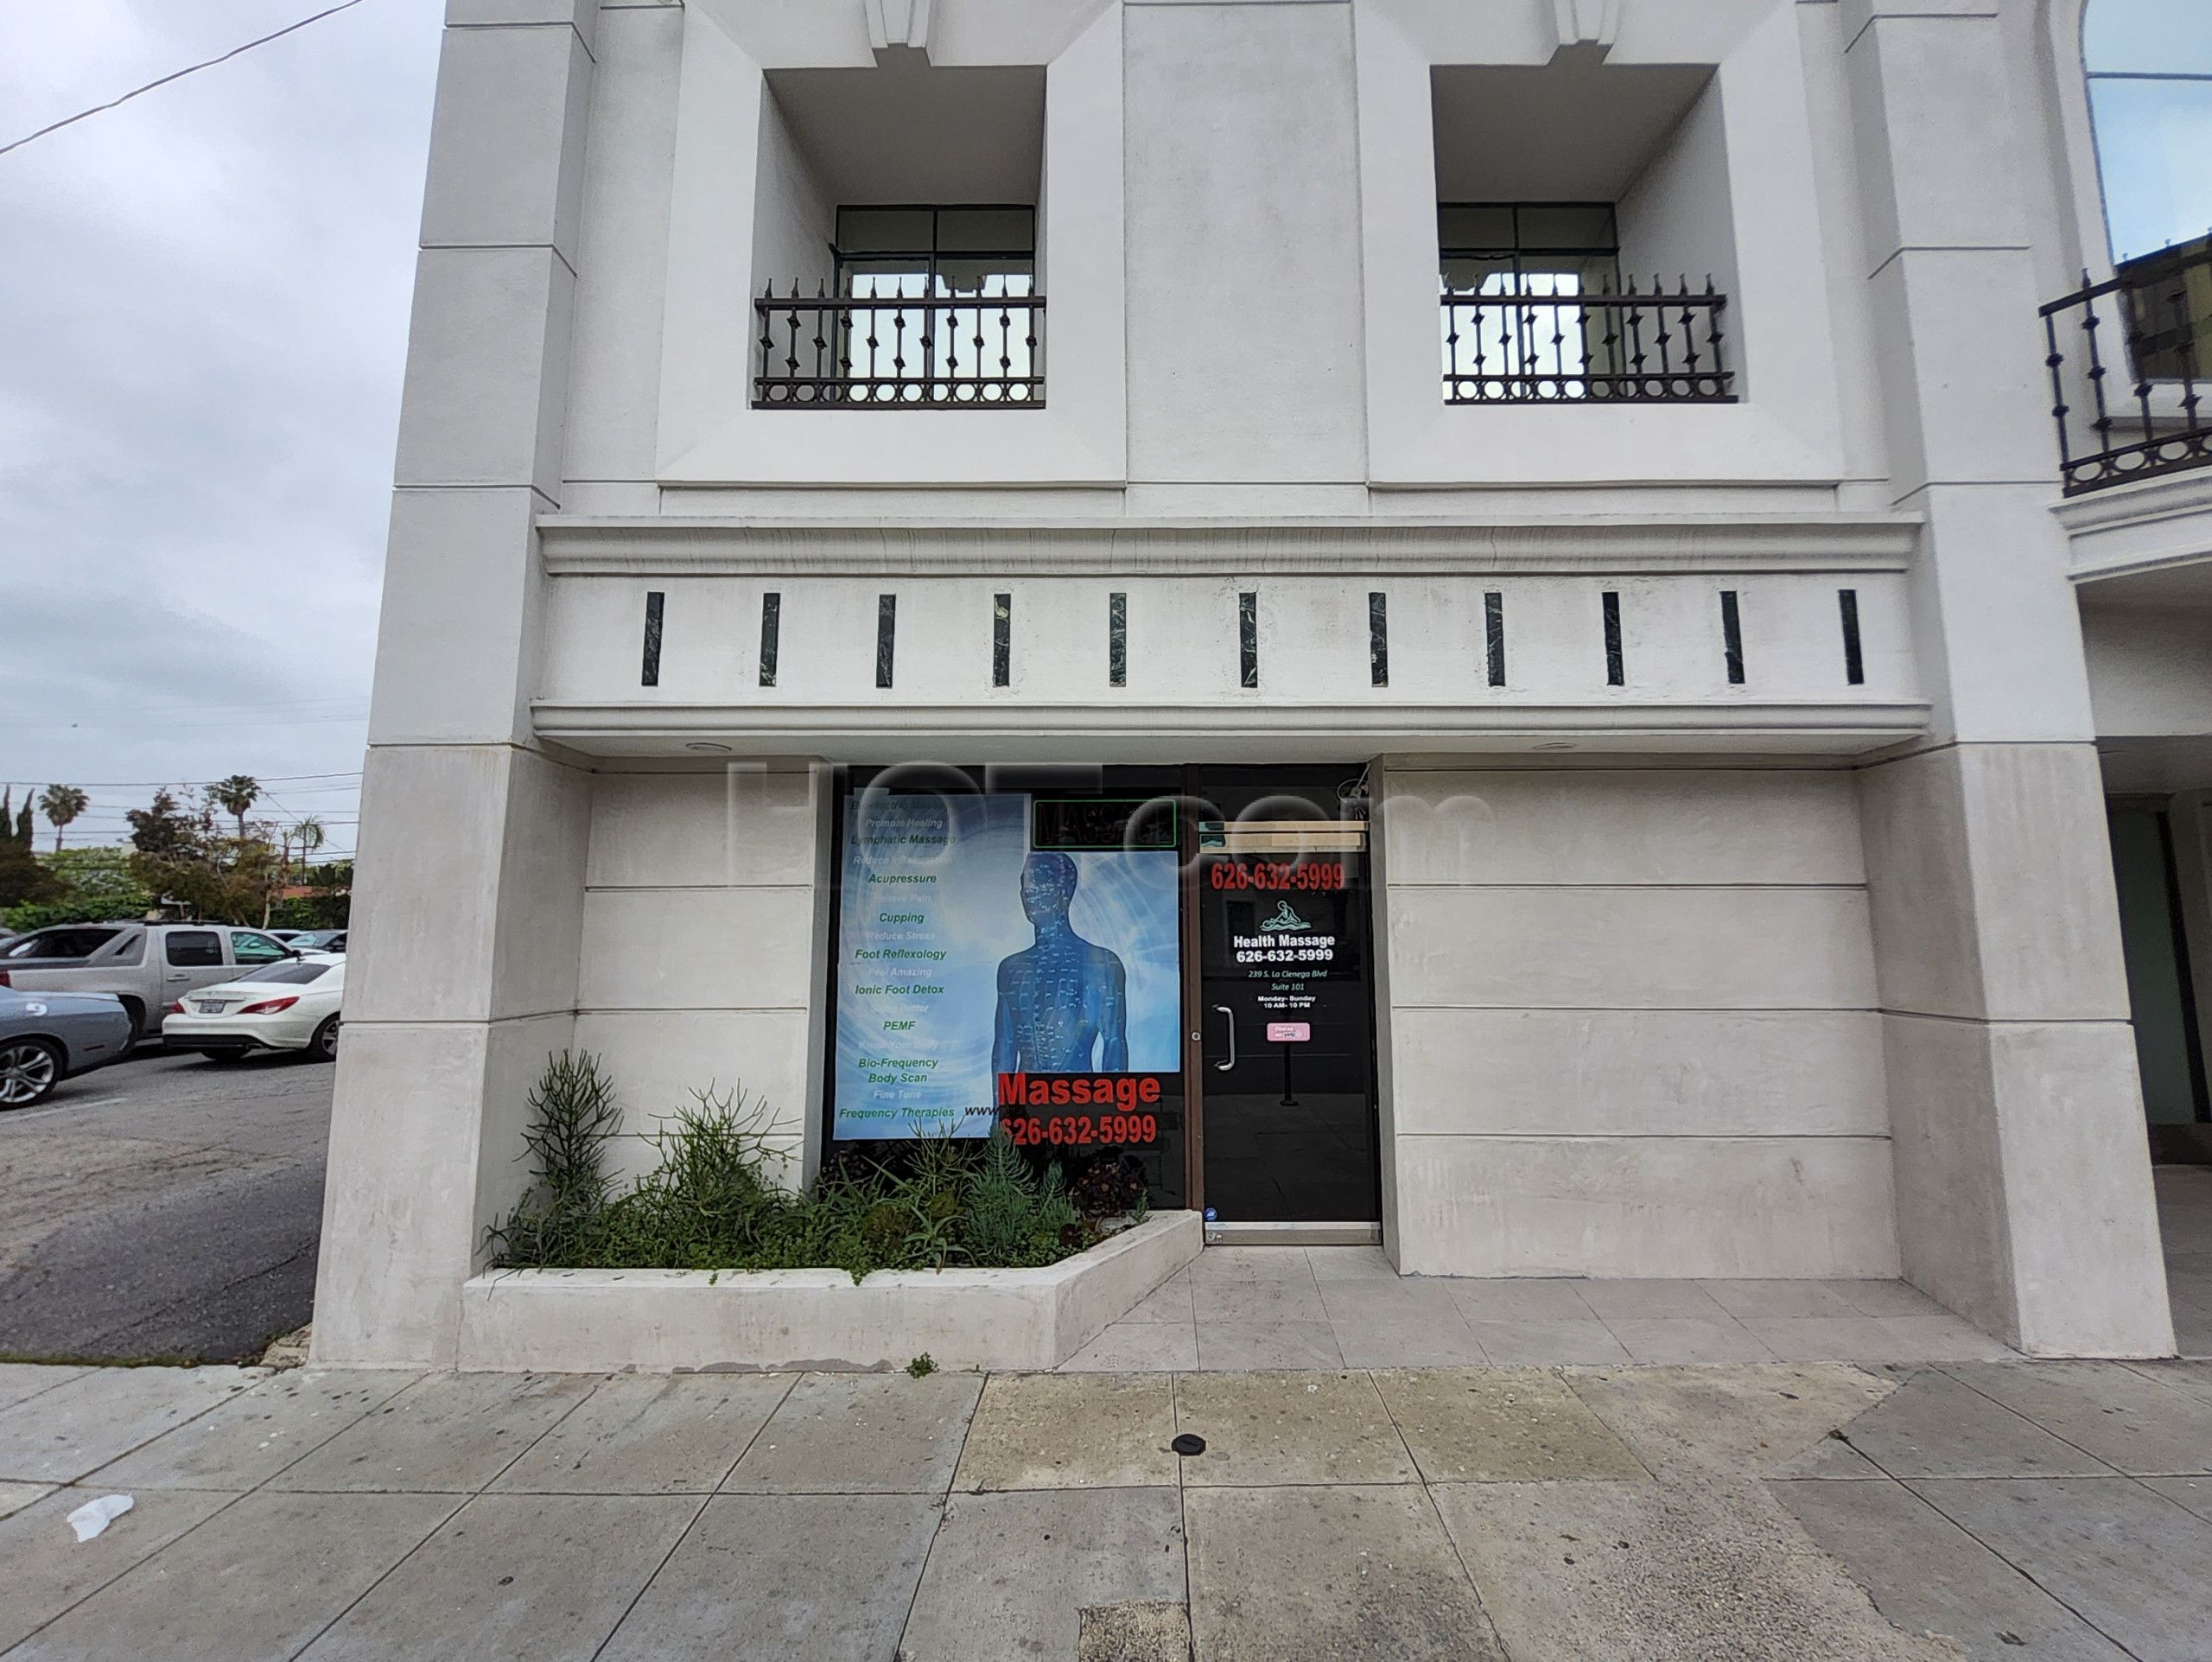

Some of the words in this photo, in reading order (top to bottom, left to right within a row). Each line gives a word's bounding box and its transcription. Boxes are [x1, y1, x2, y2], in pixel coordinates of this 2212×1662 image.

[906, 818, 943, 829] Healing
[868, 873, 937, 885] Acupressure
[1211, 863, 1344, 890] 626-632-5999
[880, 913, 925, 924] Cupping
[1233, 935, 1275, 947] Health
[1279, 934, 1335, 948] Massage
[855, 949, 880, 958] Foot
[882, 949, 947, 960] Reflexology
[1236, 949, 1333, 963] 626-632-5999
[890, 968, 932, 977] Amazing
[855, 985, 882, 995] Ionic
[885, 985, 910, 995] Foot
[912, 985, 944, 995] Detox
[883, 1021, 916, 1030] PEMF
[859, 1058, 938, 1071] Bio-Frequency
[868, 1073, 898, 1084] Body
[899, 1073, 927, 1083] Scan
[874, 1090, 895, 1099] Fine
[897, 1090, 922, 1098] Tune
[998, 1073, 1160, 1111] Massage
[839, 1109, 898, 1119] Frequency
[901, 1108, 955, 1118] Therapies
